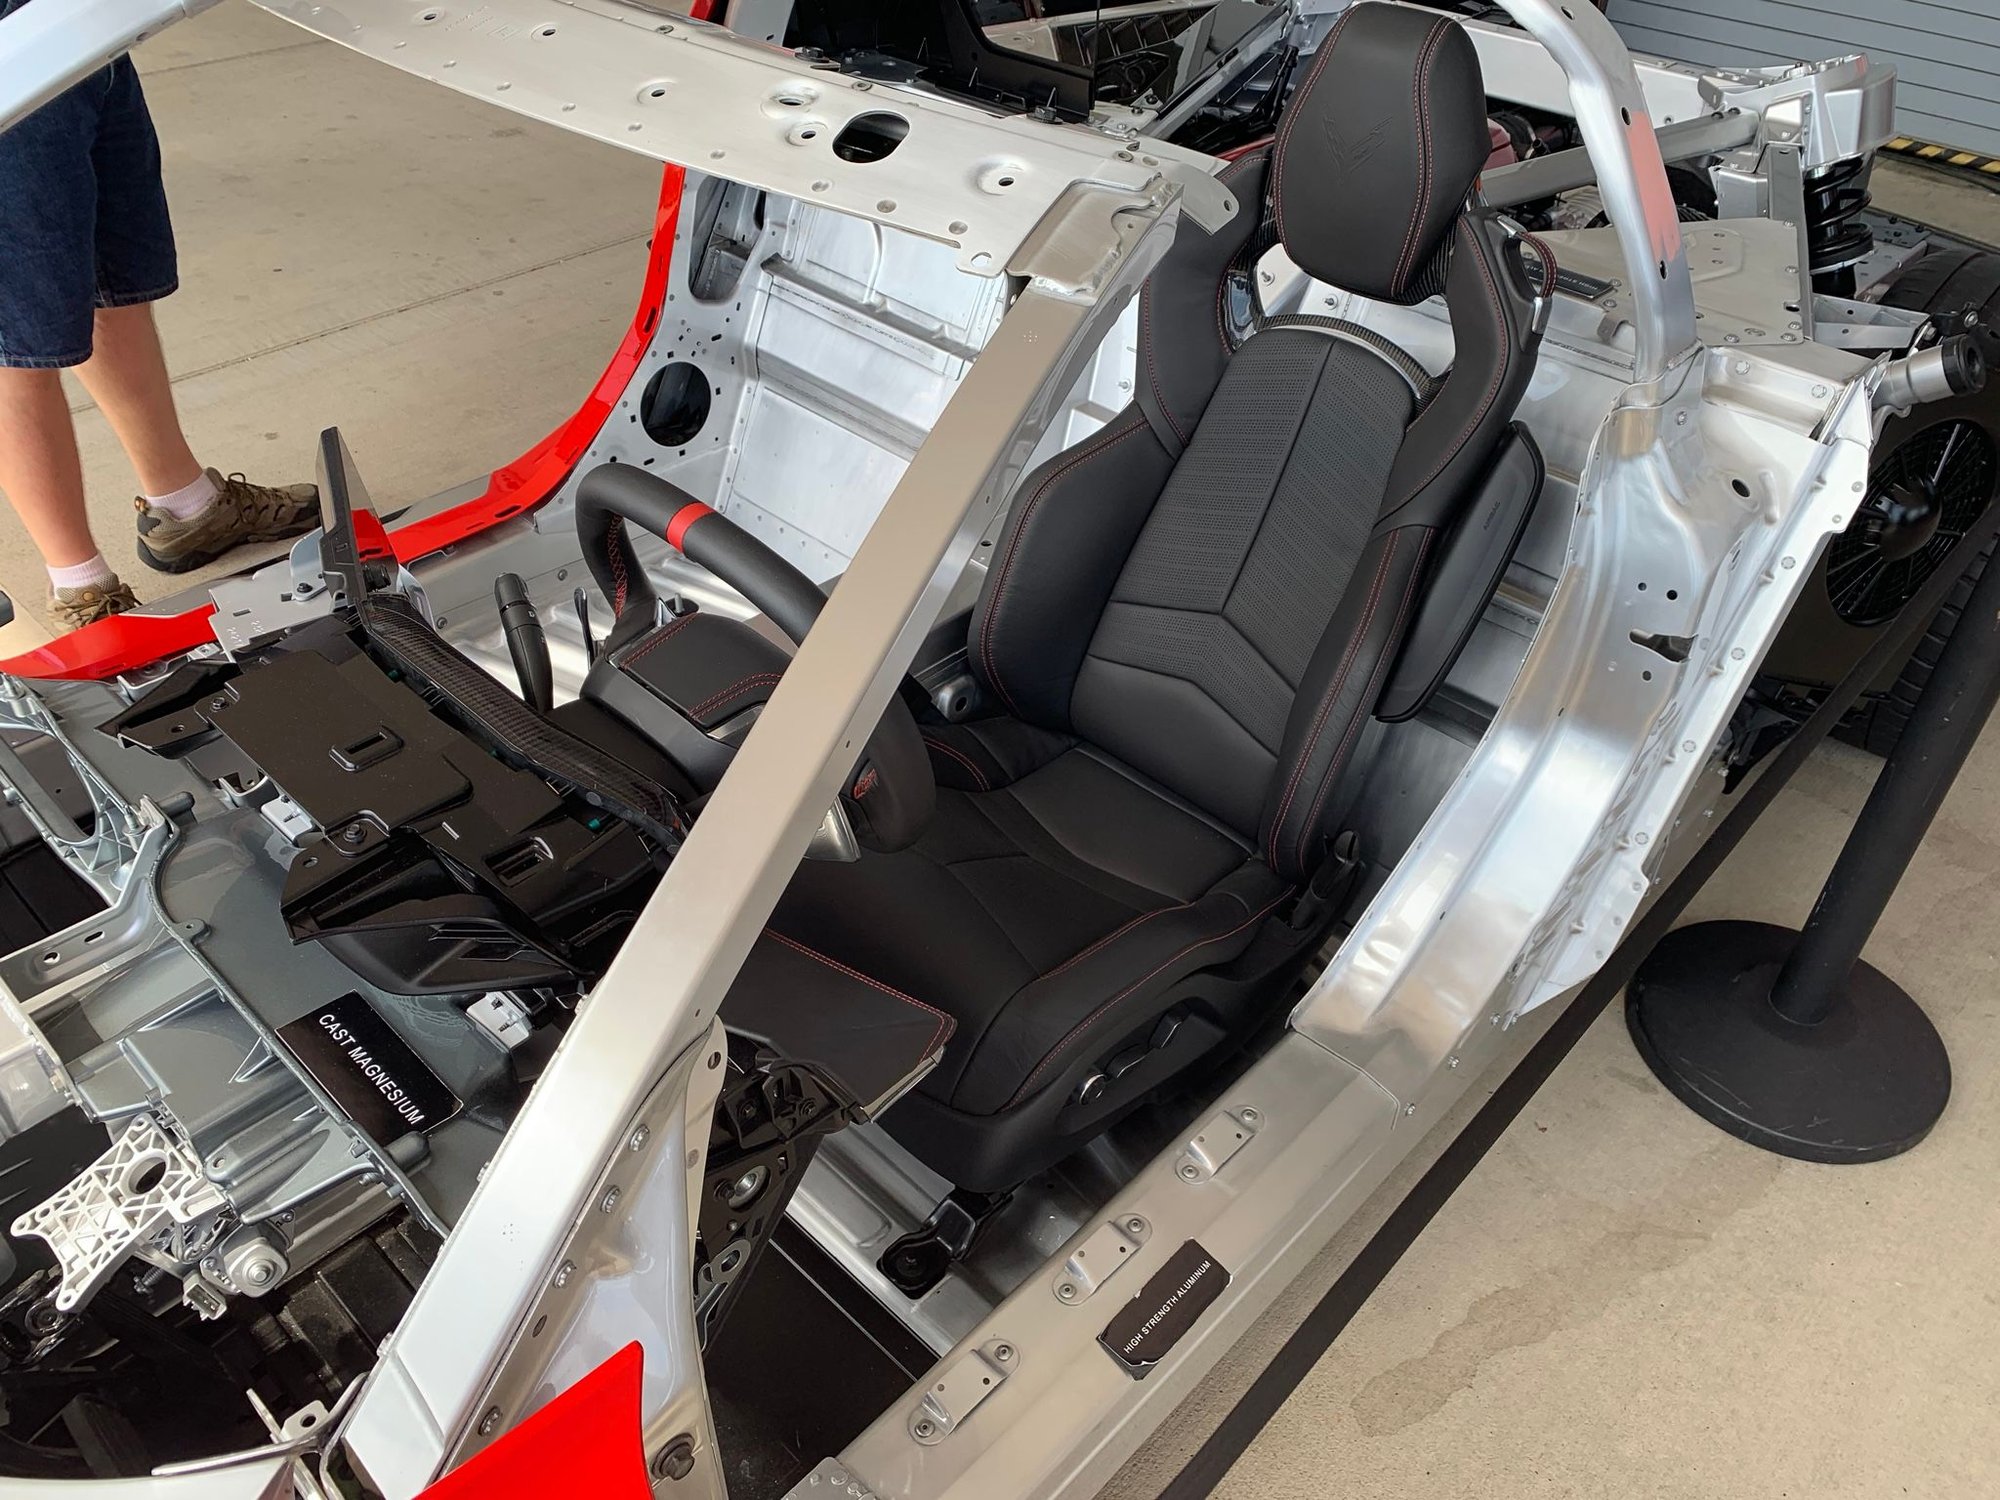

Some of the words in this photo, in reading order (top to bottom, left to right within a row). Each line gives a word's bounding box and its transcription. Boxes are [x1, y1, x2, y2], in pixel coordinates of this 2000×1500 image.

[319, 1014, 356, 1046] CAST
[348, 1046, 425, 1125] MAGNESIUM
[1123, 1334, 1144, 1354] HIGH
[1141, 1295, 1179, 1335] STRENGTH
[1177, 1260, 1211, 1298] ALUMINUM
